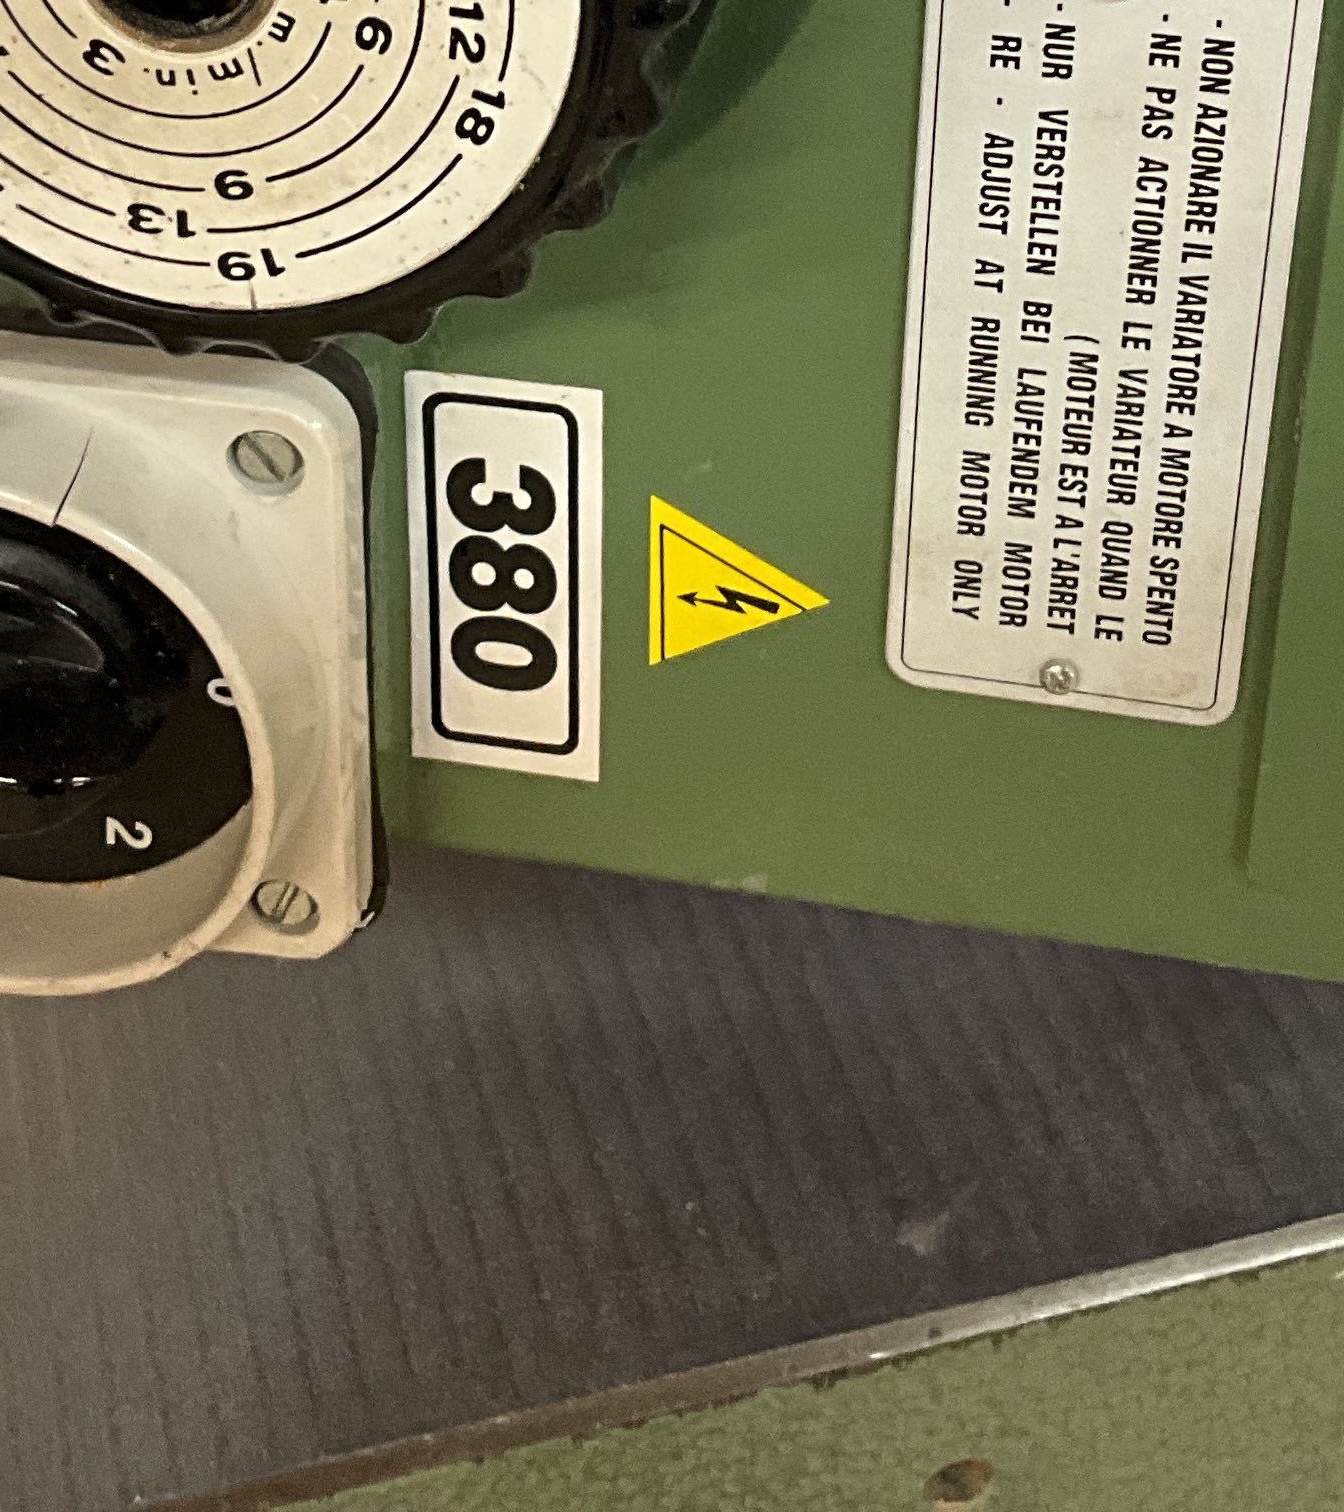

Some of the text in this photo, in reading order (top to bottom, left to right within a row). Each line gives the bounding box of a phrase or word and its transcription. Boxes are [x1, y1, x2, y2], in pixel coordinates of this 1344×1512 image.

[82, 38, 127, 77] 3
[142, 11, 298, 97] m./min.
[354, 16, 393, 56] 6
[448, 1, 487, 65] 12
[989, 34, 1023, 71] RE
[1040, 22, 1077, 80] NUR
[1147, 32, 1183, 69] NE
[1198, 37, 1236, 96] NON
[454, 88, 506, 147] 18
[1140, 85, 1177, 141] PAS
[213, 169, 255, 201] 9
[977, 132, 1015, 236] ADJUST
[1025, 109, 1070, 276] VERSTELLEN
[1183, 102, 1229, 235] AZIONARE
[126, 202, 197, 239] 13
[1124, 155, 1170, 306] ACTIONNER
[216, 247, 287, 282] 19
[973, 258, 1006, 294] AT
[1180, 241, 1214, 264] IL
[1019, 300, 1054, 344] BEI
[1120, 320, 1154, 352] LE
[1164, 274, 1210, 417] VARIATORE
[964, 316, 1001, 428] RUNNING
[1060, 351, 1100, 457] MOTEUR
[1162, 422, 1194, 439] A
[1006, 367, 1048, 520] LAUFENDEM
[1105, 368, 1150, 506] VARIATEUR
[956, 449, 992, 537] MOTOR
[1056, 462, 1089, 510] EST
[1151, 446, 1192, 550] MOTORE
[1054, 513, 1085, 530] A
[447, 454, 559, 693] 380
[951, 559, 984, 621] ONLY
[998, 541, 1034, 628] MOTOR
[1046, 536, 1083, 636] L'ARRET
[1097, 520, 1134, 601] QUAND
[1093, 613, 1126, 643] LE
[1141, 554, 1180, 647] SPENTO
[104, 815, 154, 850] 2
